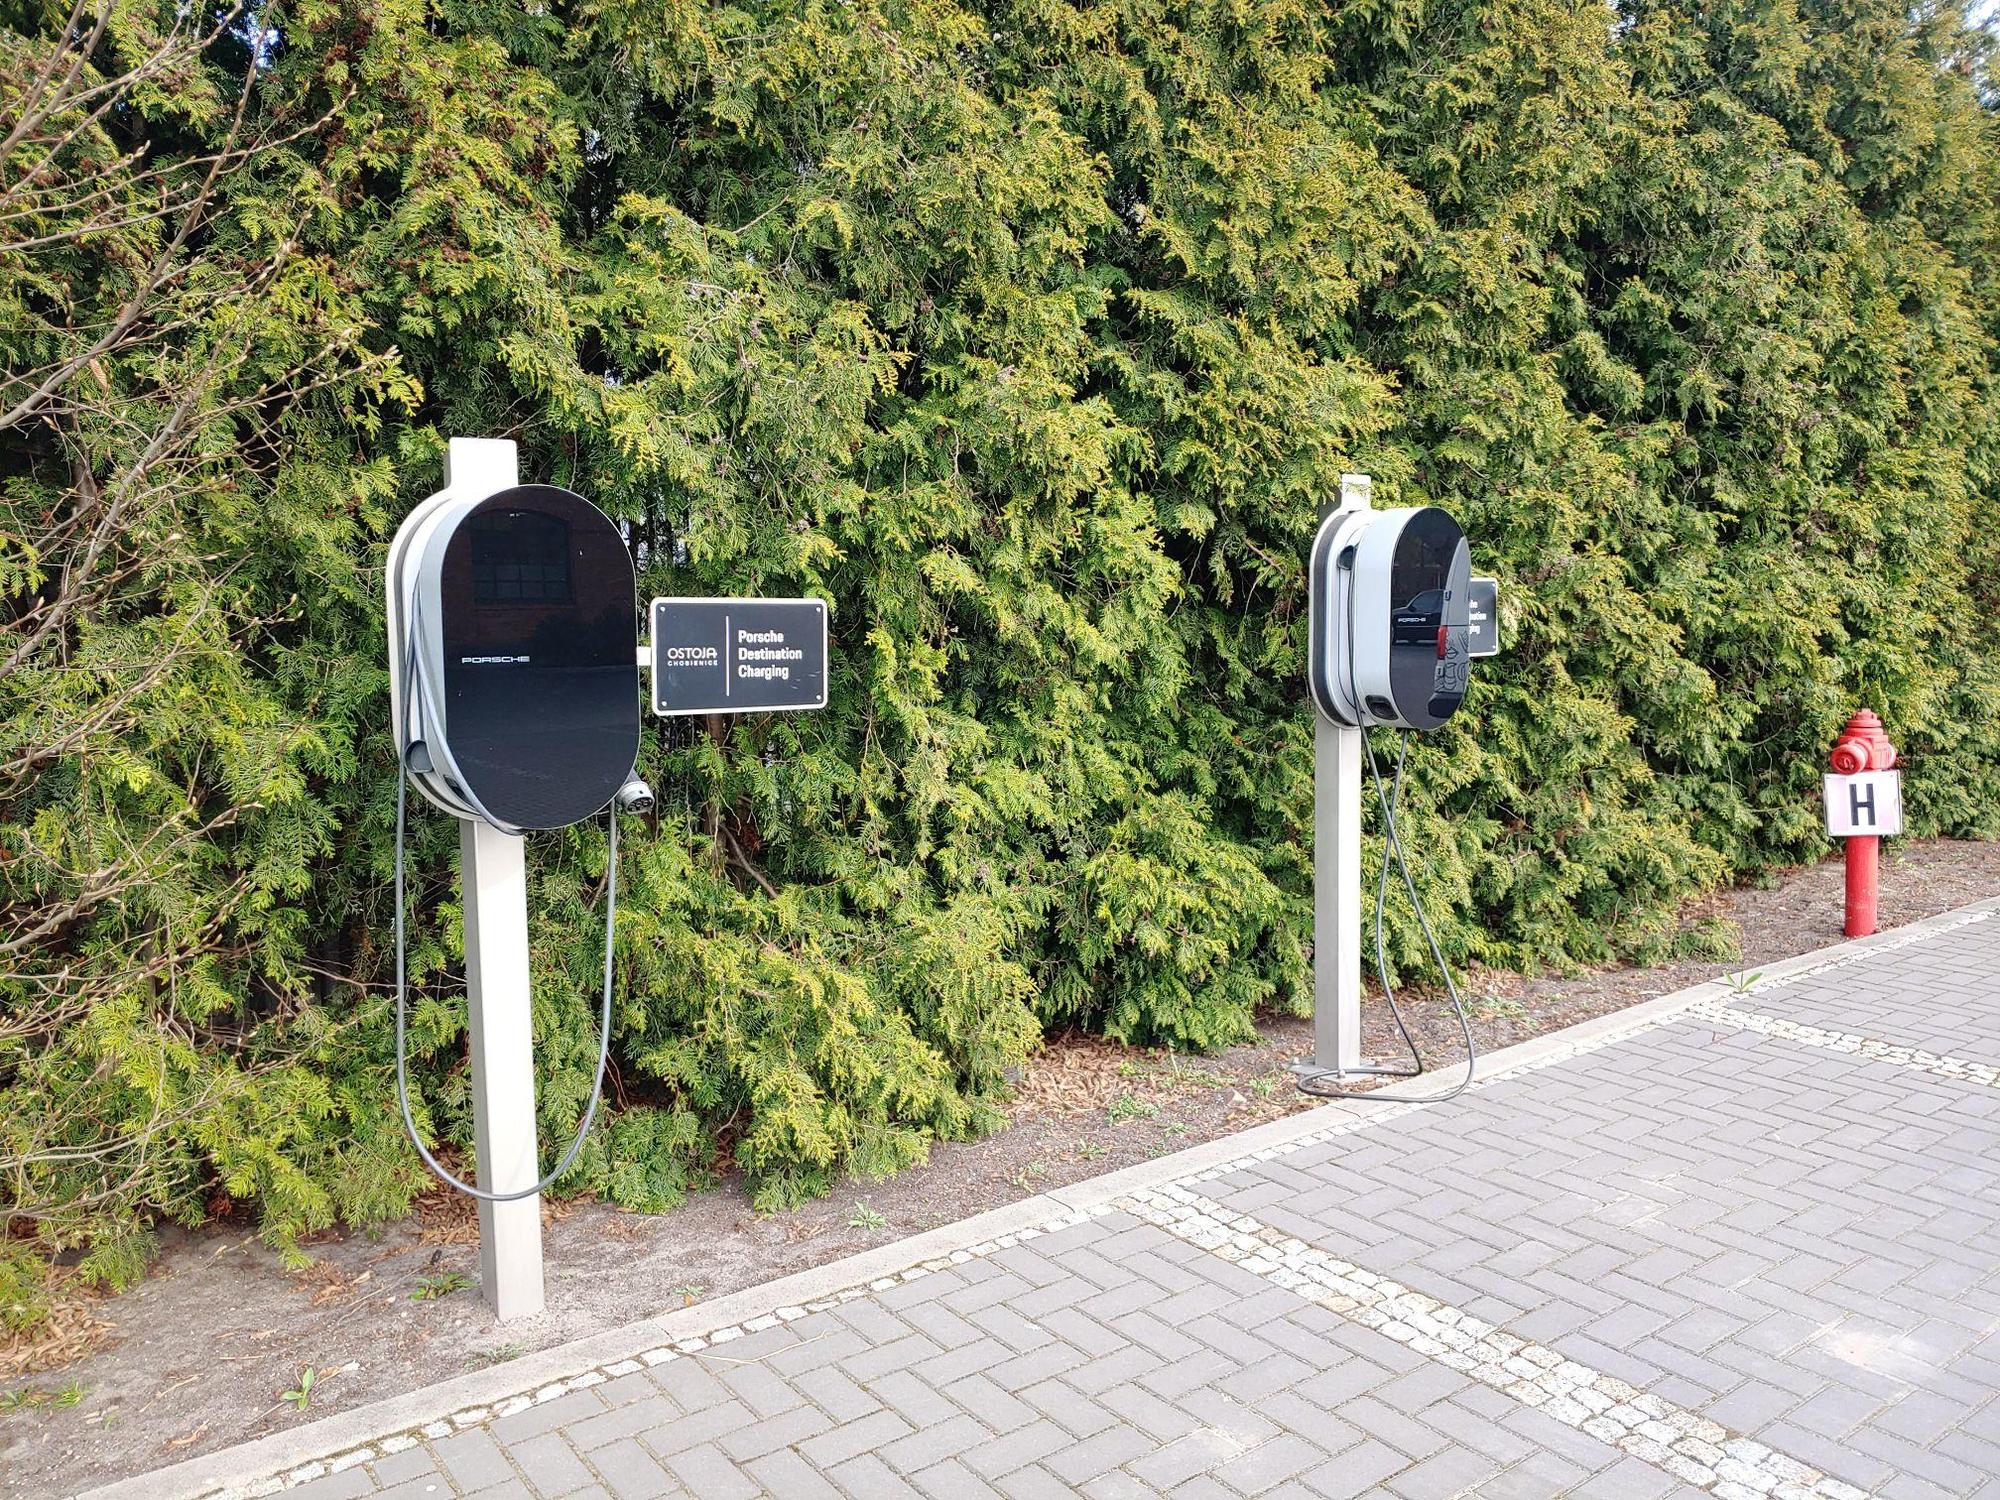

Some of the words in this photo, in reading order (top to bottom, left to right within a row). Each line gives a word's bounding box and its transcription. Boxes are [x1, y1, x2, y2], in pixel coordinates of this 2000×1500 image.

[738, 629, 784, 643] Porsche
[461, 655, 530, 664] PORSCHE
[667, 647, 718, 660] OSTOJA
[738, 647, 802, 661] Destination
[738, 664, 789, 681] Charging
[1849, 783, 1876, 826] H
